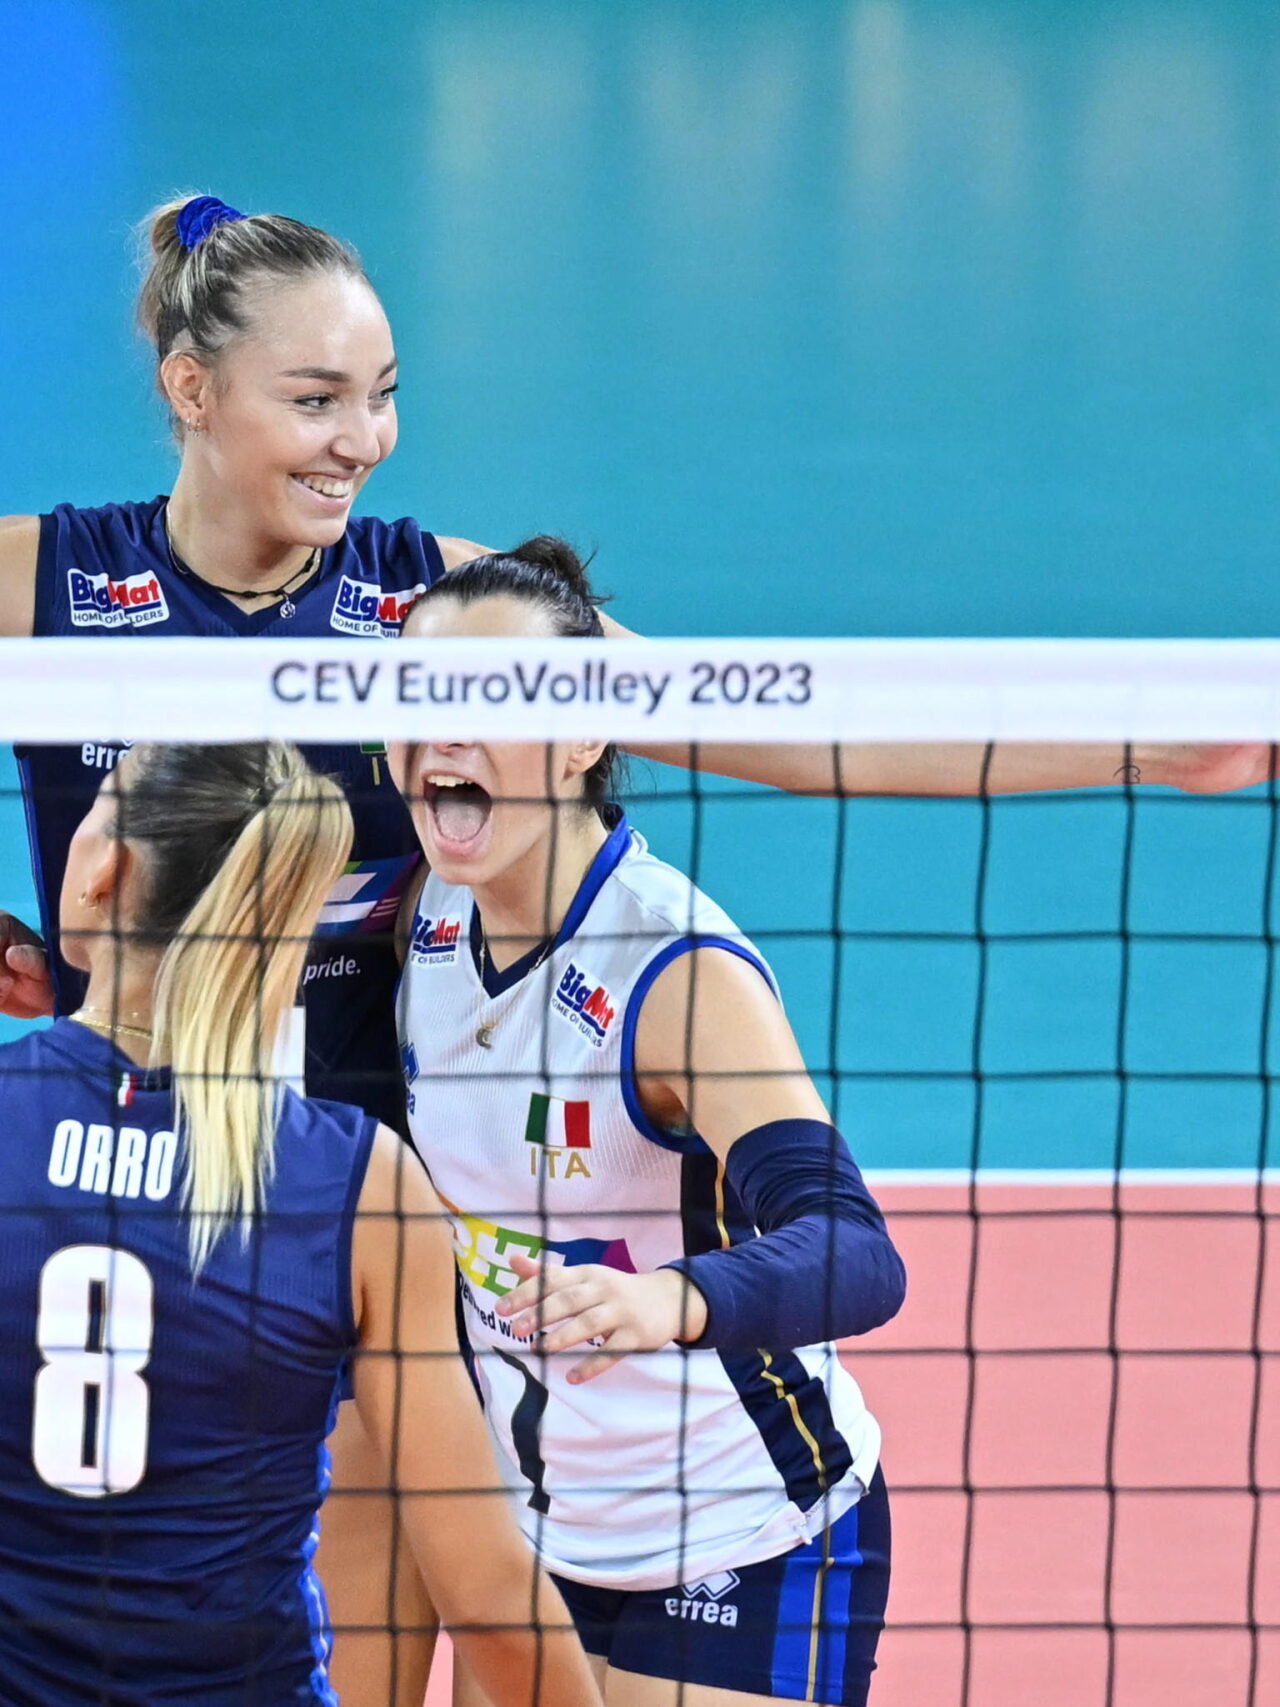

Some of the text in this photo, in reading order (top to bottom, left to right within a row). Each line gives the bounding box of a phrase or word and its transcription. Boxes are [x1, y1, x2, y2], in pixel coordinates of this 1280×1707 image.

[338, 580, 423, 622] BigMa
[332, 614, 360, 632] HOME
[363, 621, 378, 632] OF
[271, 660, 812, 713] CEV EuroVolley 2023
[82, 742, 130, 770] err
[303, 955, 361, 986] pride.
[48, 1119, 178, 1201] ORRO
[531, 1147, 592, 1179] ITA
[32, 1243, 154, 1497] 8
